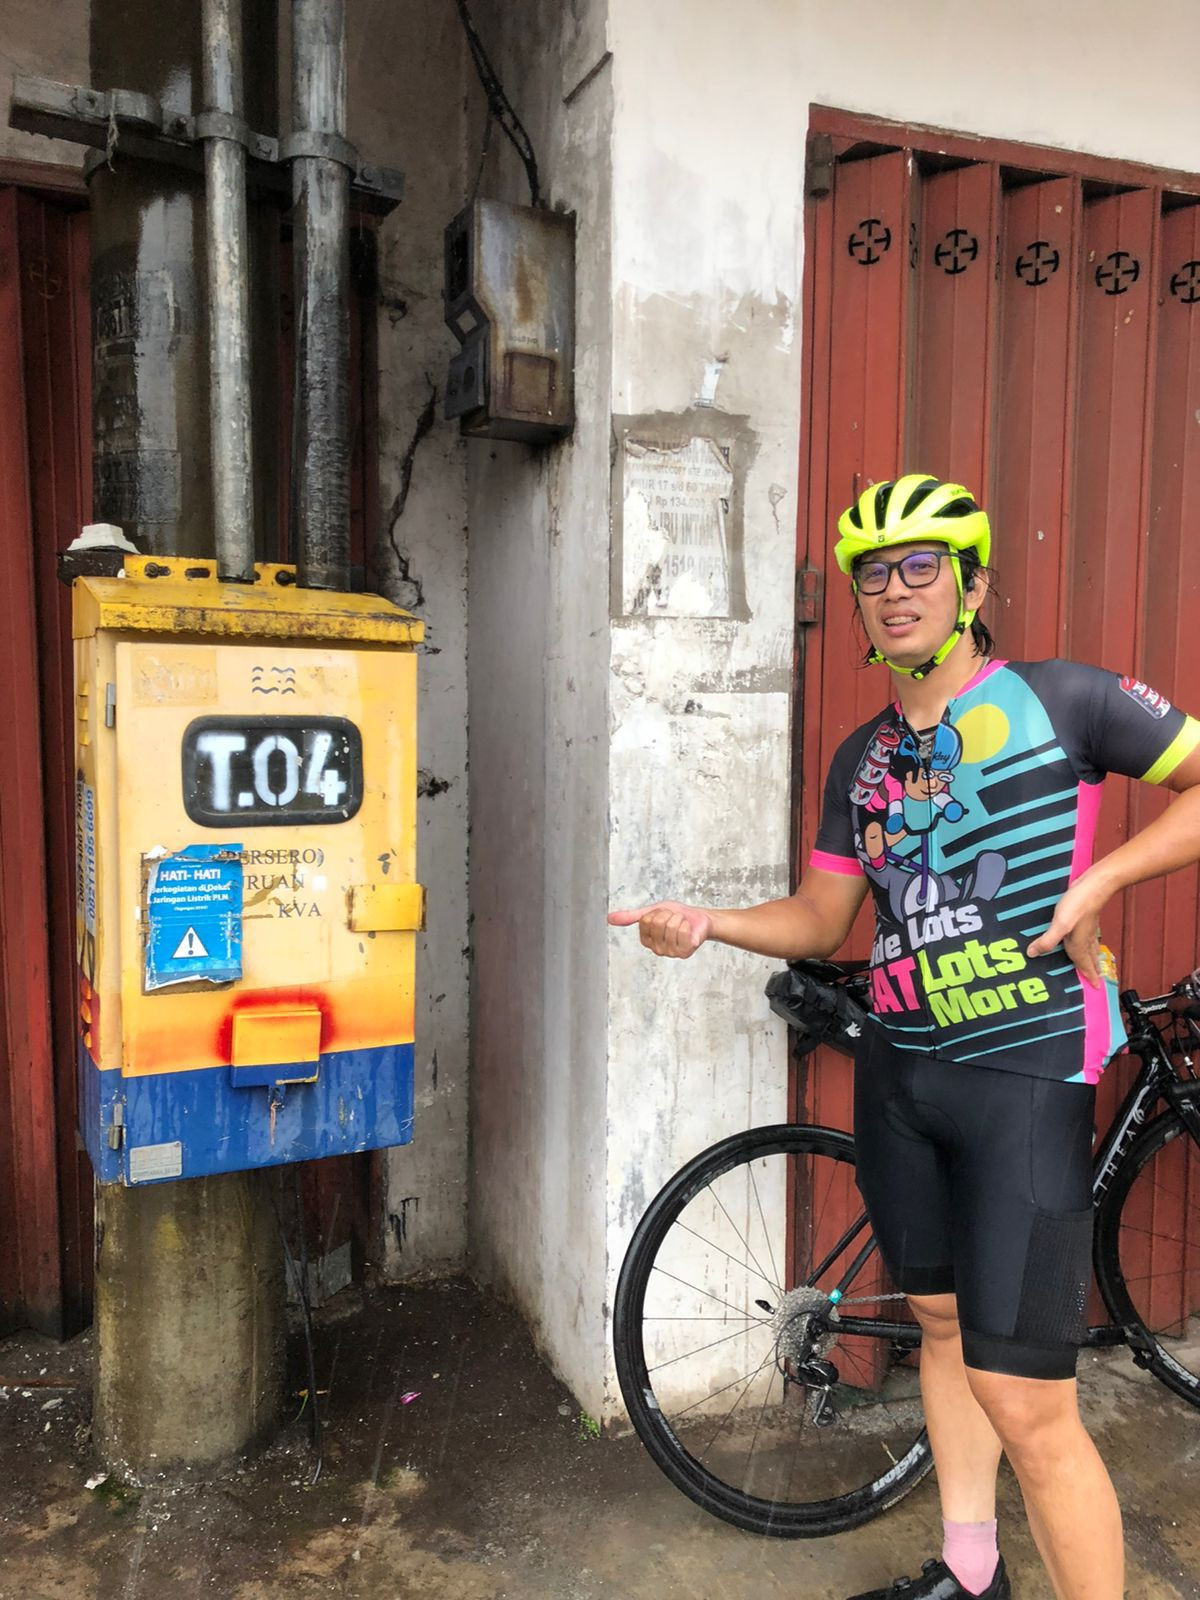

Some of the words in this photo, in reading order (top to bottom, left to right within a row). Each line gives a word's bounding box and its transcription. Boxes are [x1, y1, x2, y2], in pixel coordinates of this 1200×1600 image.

[220, 848, 324, 867] ERSERO)
[193, 868, 221, 880] HATI
[241, 873, 305, 890] RUAN
[212, 892, 229, 901] PLN
[278, 902, 322, 918] KVA
[906, 904, 984, 950] Lots
[868, 956, 921, 1014] AT
[916, 937, 1027, 994] Lots
[927, 976, 1050, 1028] More
